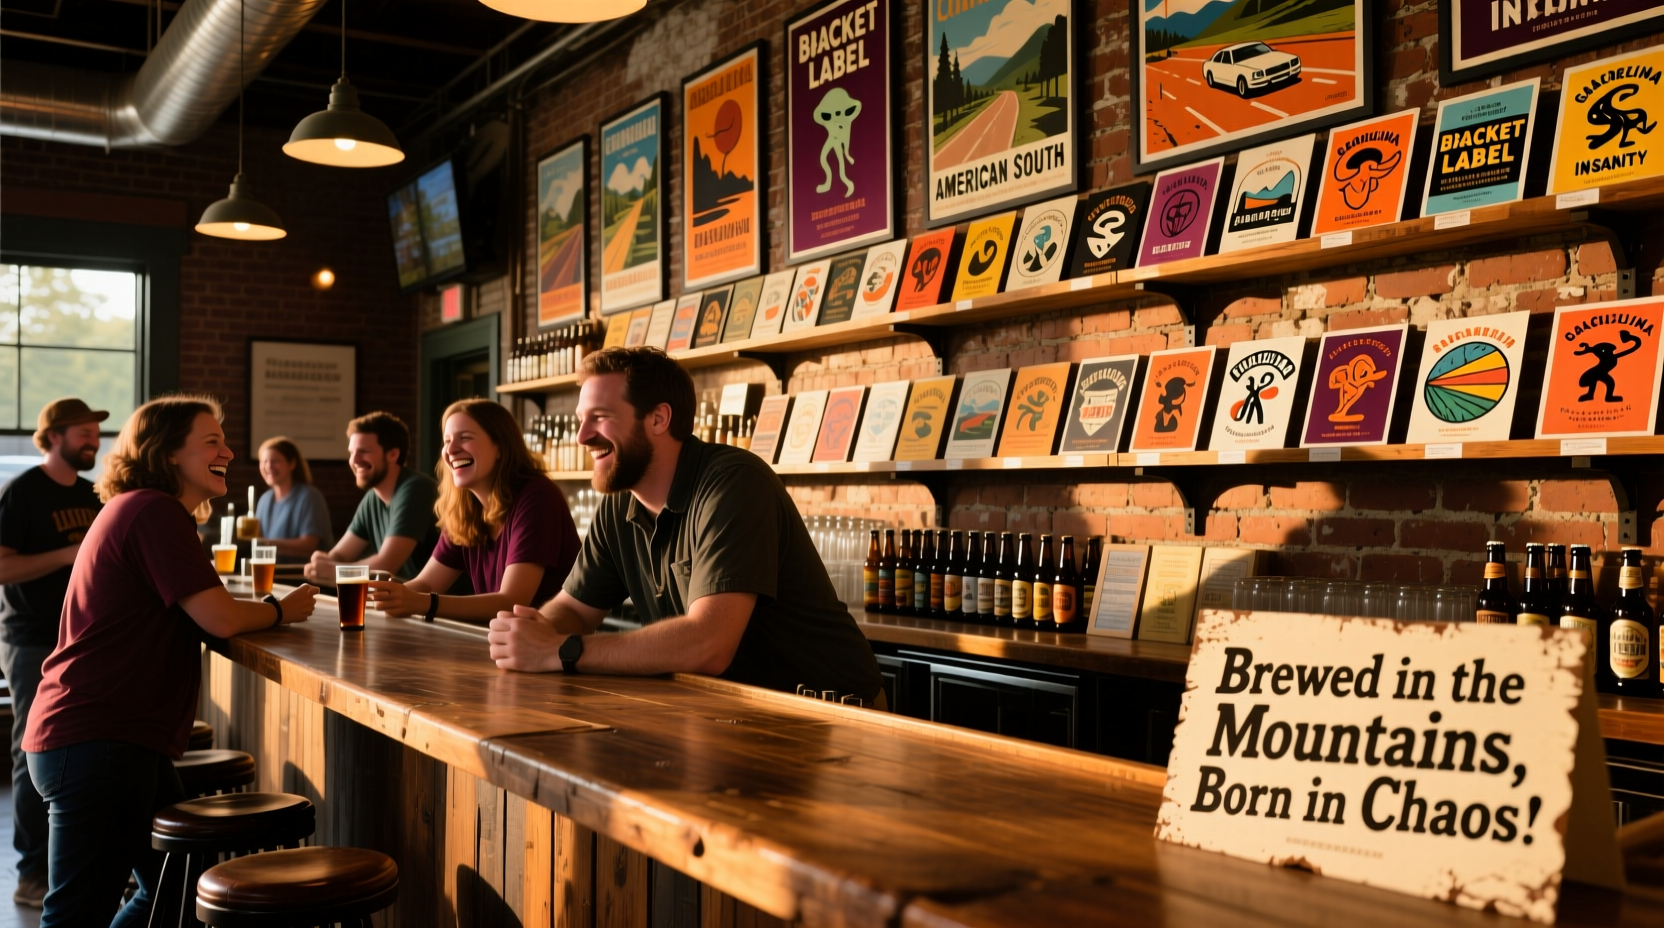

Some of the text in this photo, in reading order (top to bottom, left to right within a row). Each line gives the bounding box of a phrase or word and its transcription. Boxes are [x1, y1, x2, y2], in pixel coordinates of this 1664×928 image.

[808, 39, 870, 90] LABEL
[936, 158, 1008, 201] AMERICAN
[1013, 142, 1065, 179] SOUTH
[1442, 142, 1515, 174] LABEL
[1575, 149, 1648, 176] INSANITY
[1215, 647, 1525, 705] Brewed in the
[1205, 702, 1527, 788] Mountains,
[1189, 765, 1542, 845] Born in Chaos!
